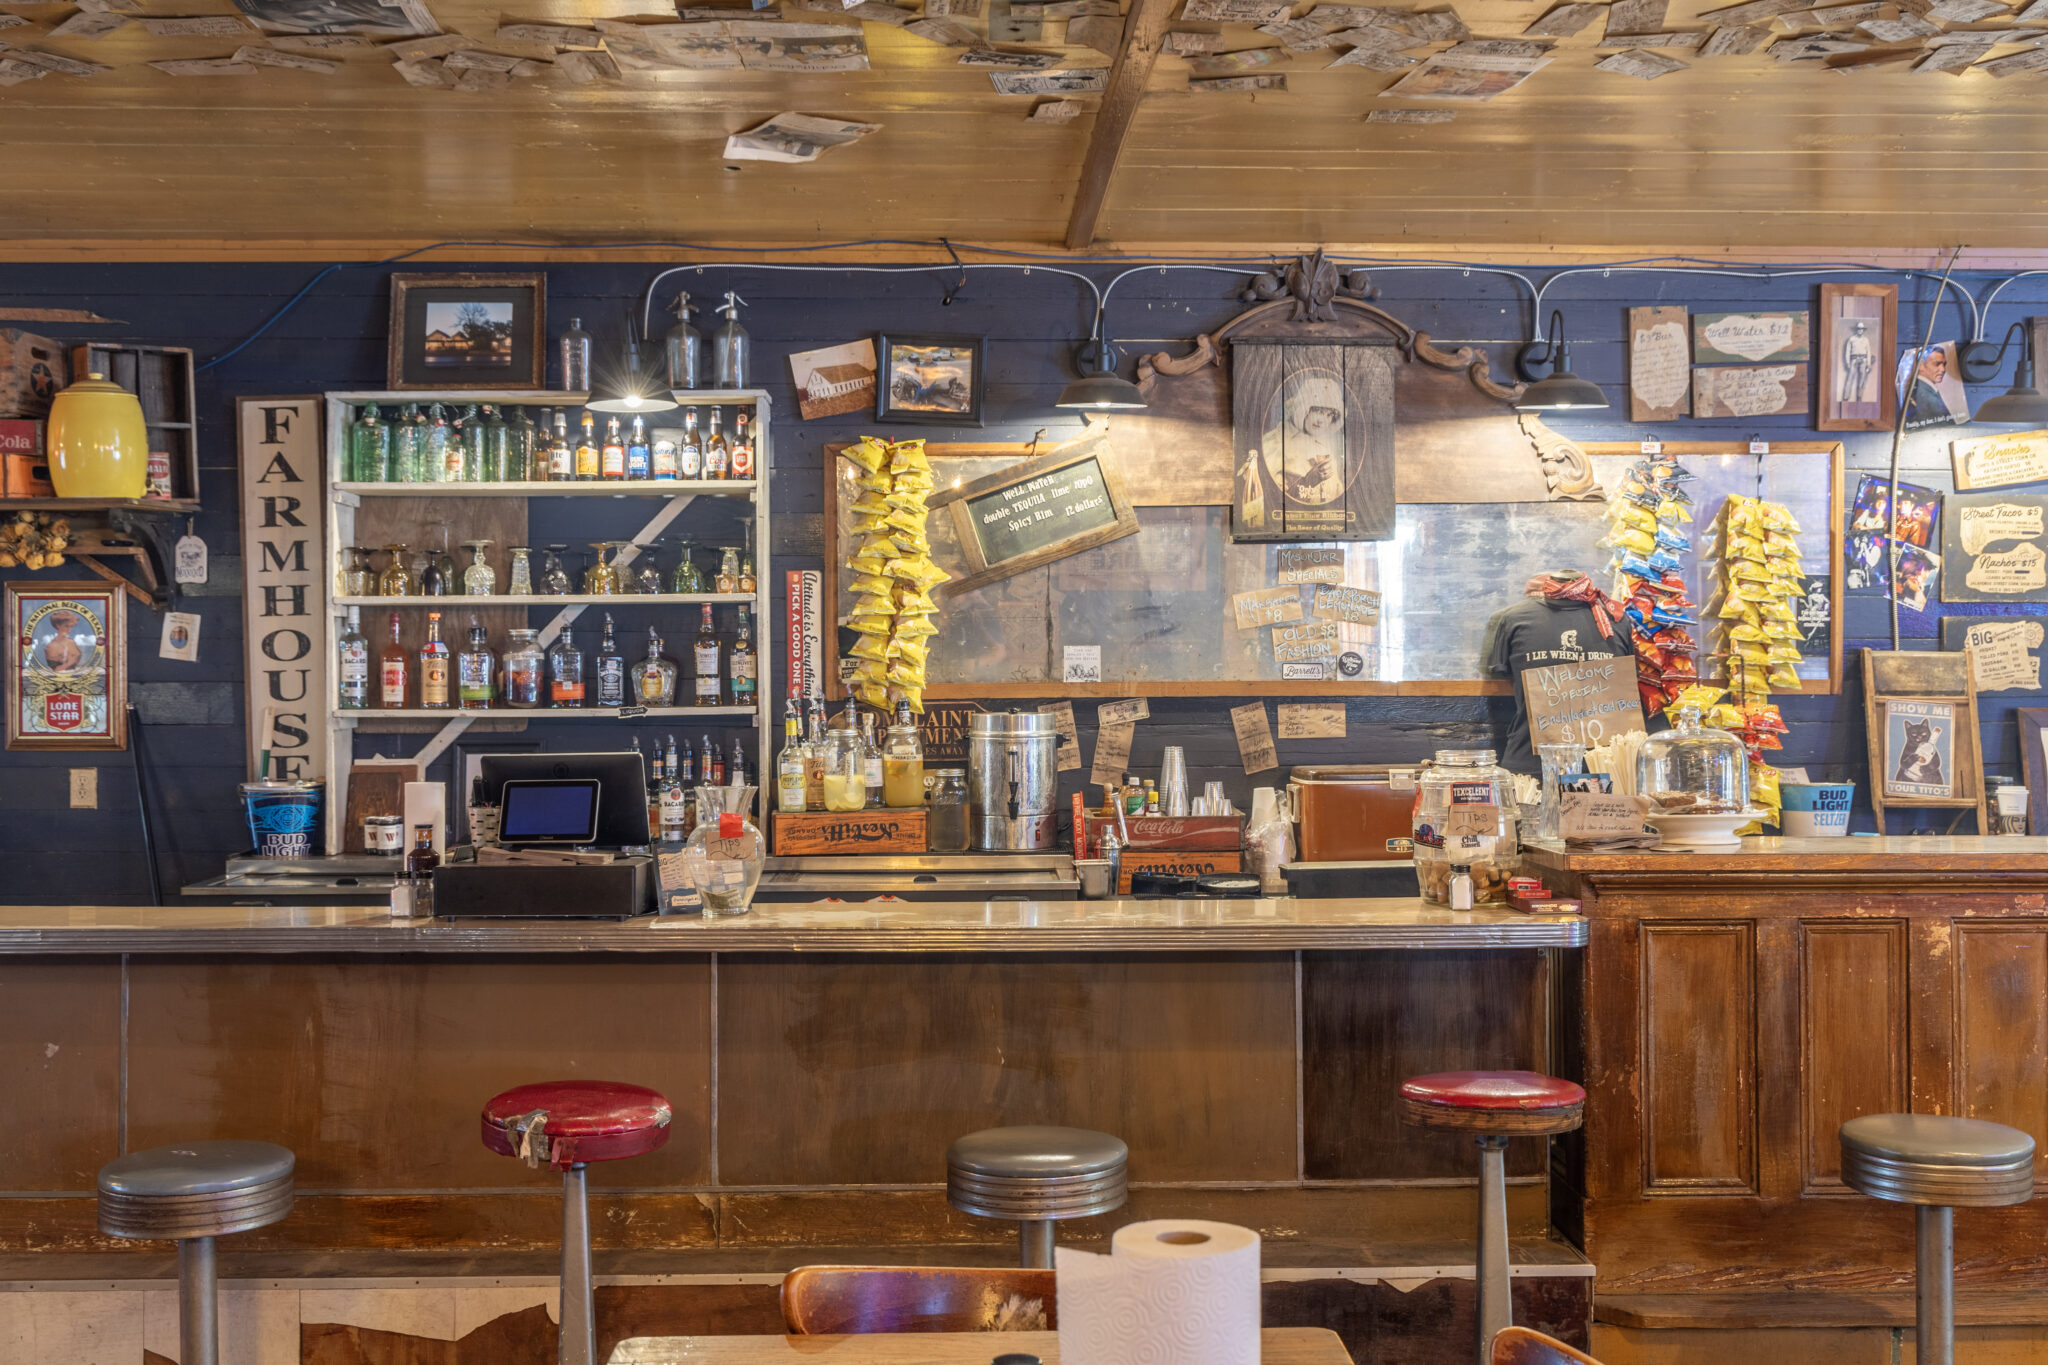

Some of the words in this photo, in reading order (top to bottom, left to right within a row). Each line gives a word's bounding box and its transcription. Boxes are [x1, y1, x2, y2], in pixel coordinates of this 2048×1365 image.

[1075, 494, 1103, 513] dollars
[983, 507, 1011, 524] double
[1963, 506, 1995, 521] Street
[1996, 505, 2024, 520] Tacos
[1979, 555, 2017, 570] Nachos
[257, 405, 312, 781] FARMHOUSE
[791, 584, 800, 611] PICK
[803, 571, 818, 620] Attitude
[791, 613, 801, 622] A
[803, 622, 814, 632] is
[1283, 624, 1317, 641] OLD
[1320, 623, 1337, 639] $8
[792, 624, 801, 658] GOOD
[1971, 630, 1994, 647] BIG
[1275, 641, 1332, 660] FASHION
[1526, 652, 1531, 662] I
[1532, 651, 1547, 660] LIE
[1550, 650, 1579, 661] WHEN
[1587, 651, 1614, 661] DRINK
[792, 661, 802, 685] ONE
[801, 635, 818, 697] Everything
[50, 701, 79, 711] LONE
[1889, 702, 1928, 715] SHOW
[1932, 705, 1951, 716] ME
[50, 712, 80, 721] STAR
[854, 710, 976, 728] COMLAINT
[1453, 786, 1490, 797] TEXCELLENT
[1819, 789, 1847, 801] BUD
[1888, 783, 1917, 794] YOUR
[1918, 785, 1951, 796] TITO'S
[1812, 799, 1849, 812] LIGHT
[1133, 819, 1185, 835] Coca-Cola
[1813, 812, 1847, 827] SELTZER
[267, 833, 307, 846] BUD
[262, 844, 311, 857] LIGHT
